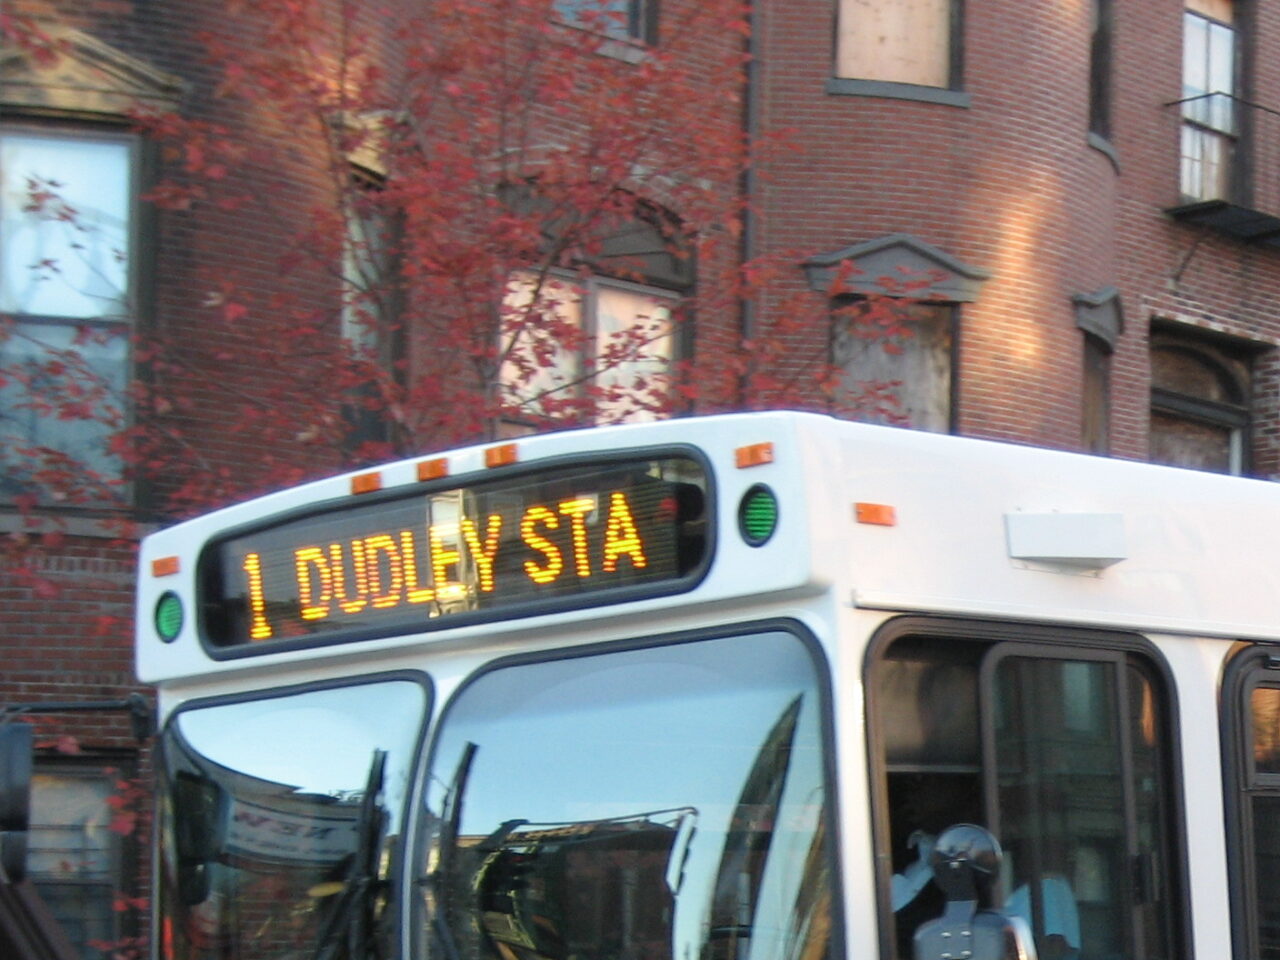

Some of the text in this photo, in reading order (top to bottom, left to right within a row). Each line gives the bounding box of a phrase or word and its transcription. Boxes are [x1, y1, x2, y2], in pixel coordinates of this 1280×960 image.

[243, 492, 647, 640] 1 DUDLEY STA
